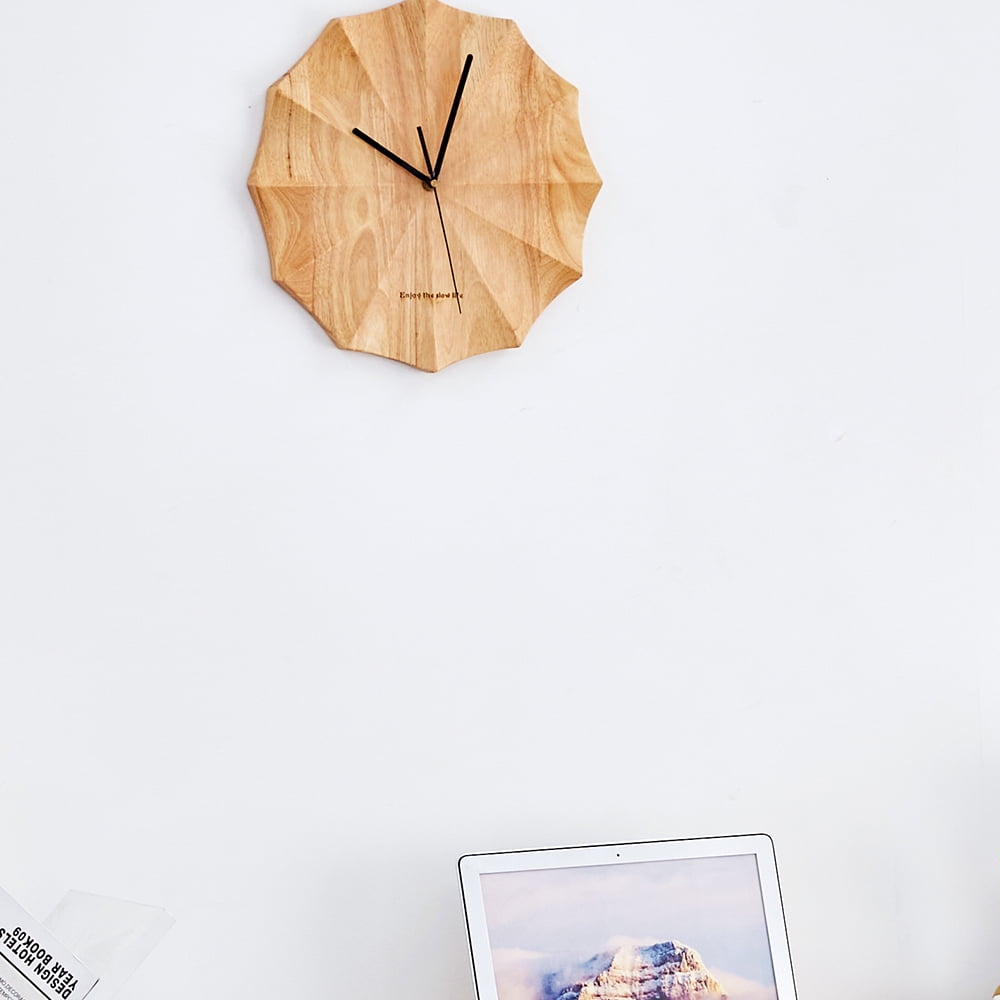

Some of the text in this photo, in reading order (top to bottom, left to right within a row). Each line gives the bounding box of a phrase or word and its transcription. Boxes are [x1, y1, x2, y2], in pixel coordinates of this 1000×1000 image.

[451, 291, 464, 299] lie
[0, 928, 73, 1000] DESIGN HOTELS
[51, 961, 79, 991] YEAR
